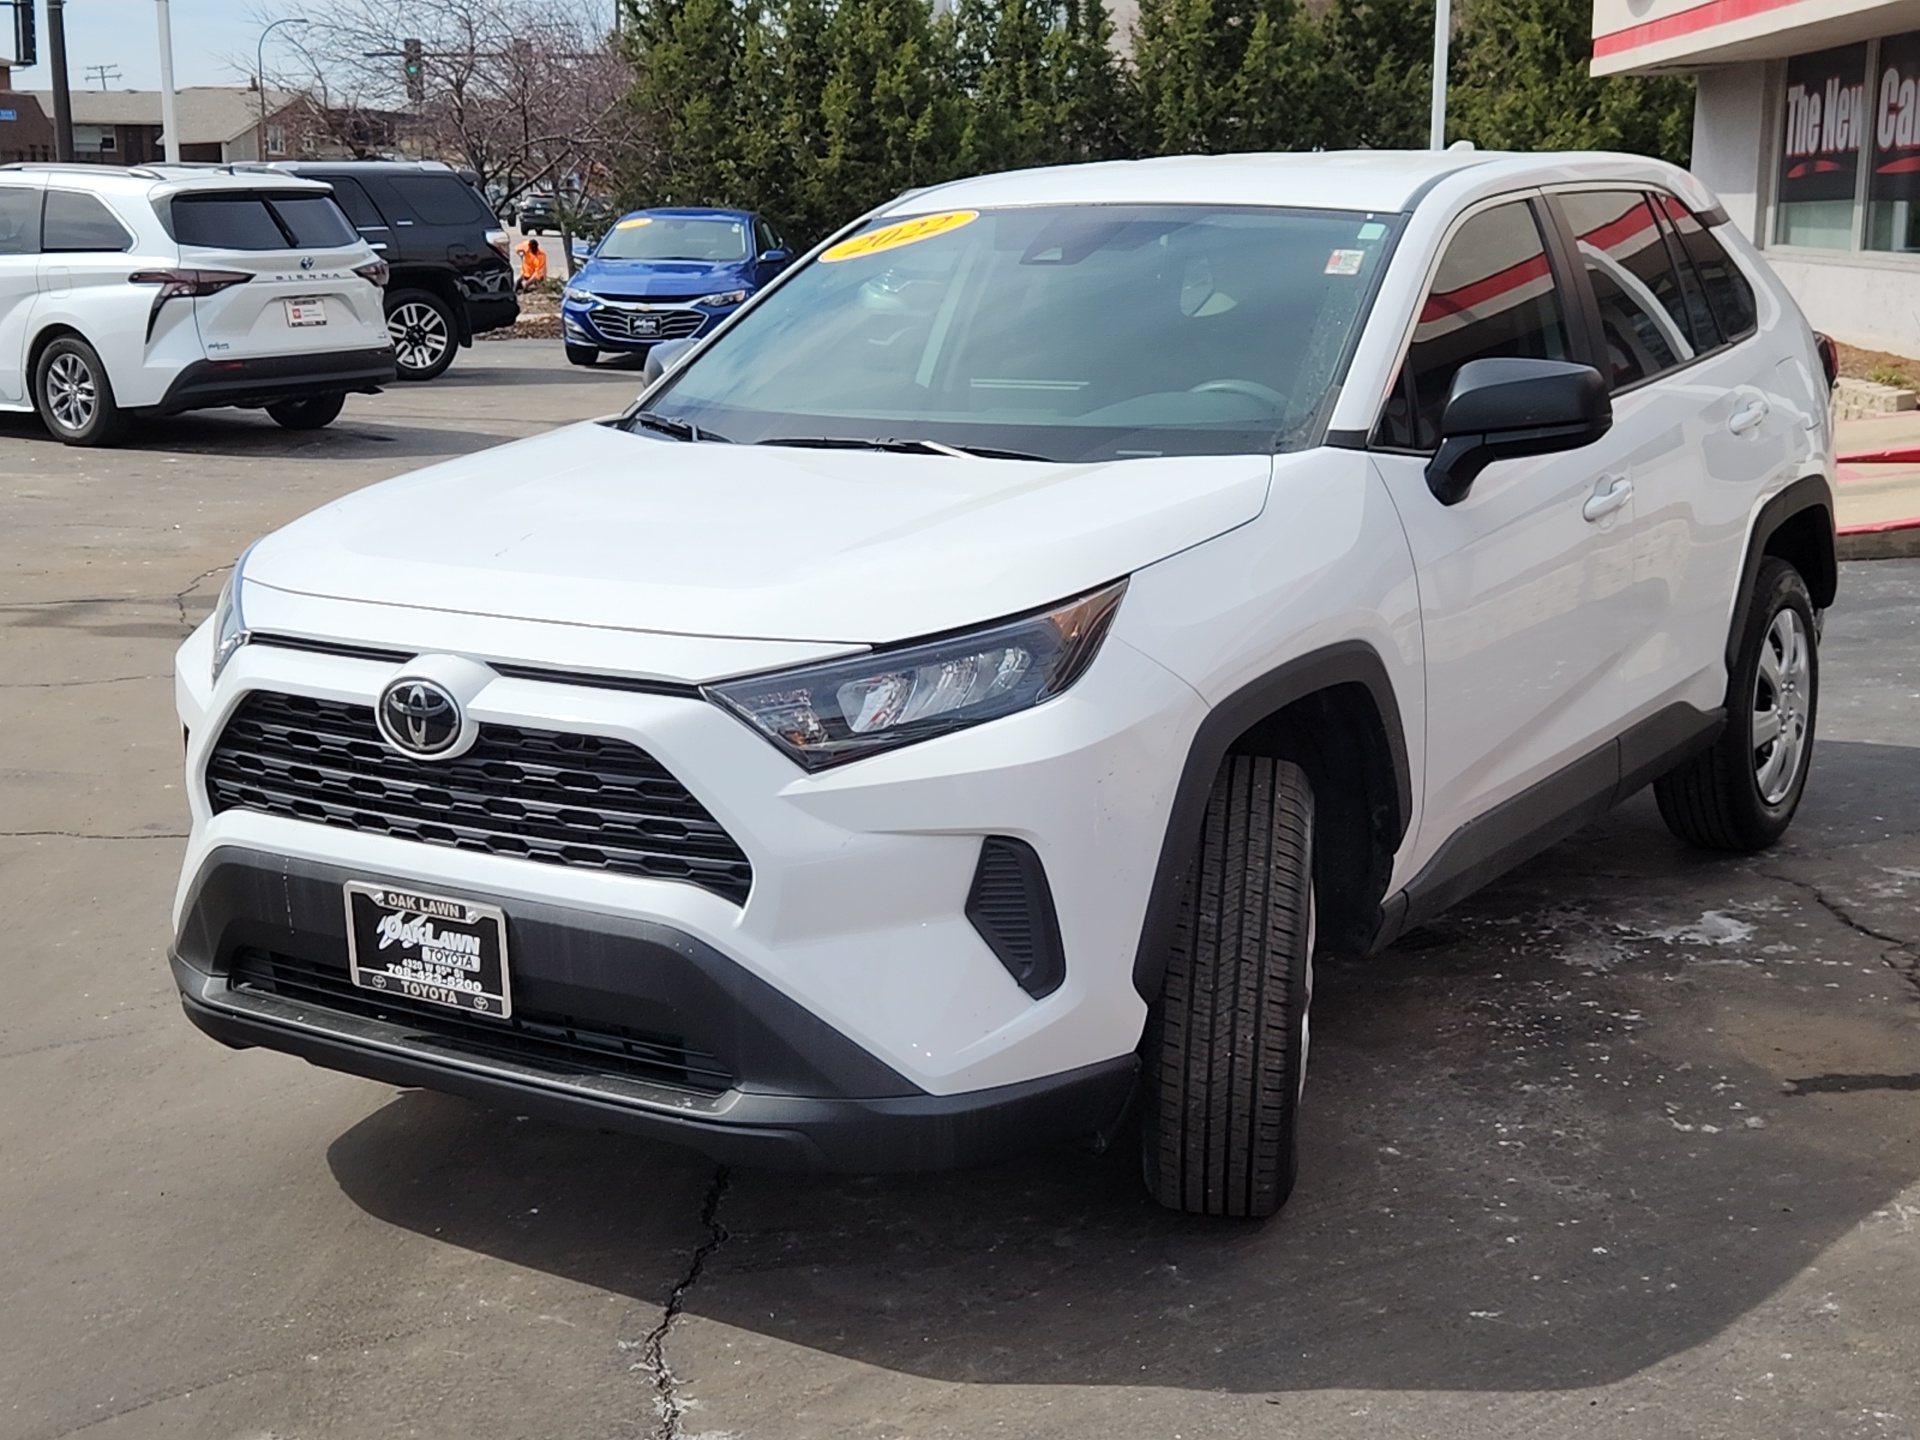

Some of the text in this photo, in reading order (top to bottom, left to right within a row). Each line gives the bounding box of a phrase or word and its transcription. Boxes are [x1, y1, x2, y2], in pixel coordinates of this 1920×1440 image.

[1786, 84, 1821, 156] The
[1821, 77, 1863, 151] New
[842, 215, 954, 256] 2022
[275, 272, 341, 281] SIENNA
[388, 893, 460, 918] OAK LAWN
[428, 948, 474, 968] TOYOTA
[401, 980, 458, 1004] TOYOTA
